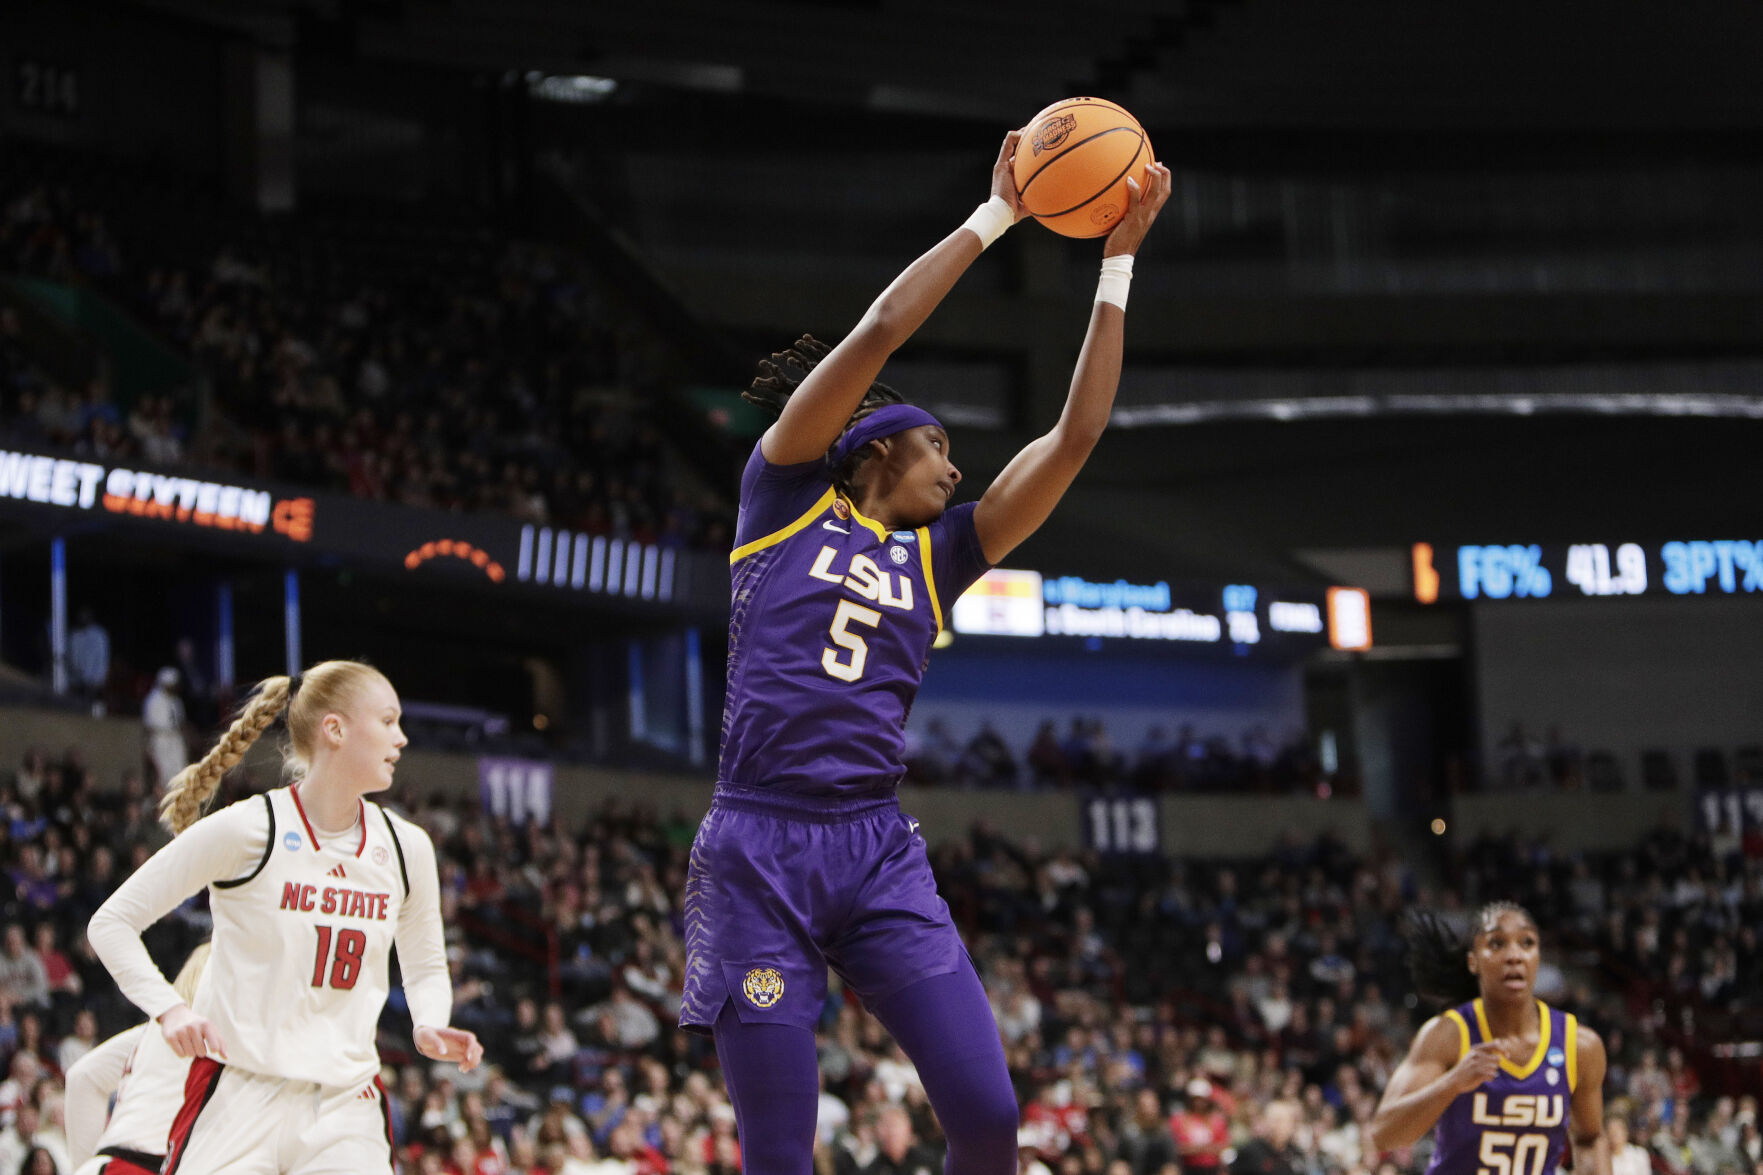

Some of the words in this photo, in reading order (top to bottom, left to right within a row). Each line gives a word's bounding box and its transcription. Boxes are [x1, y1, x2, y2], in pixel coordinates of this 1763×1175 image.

[808, 545, 914, 611] LSU
[1457, 544, 1552, 599] FG%
[821, 598, 882, 683] 5
[487, 765, 550, 828] 114
[1091, 799, 1157, 852] 113
[280, 881, 317, 912] NC
[320, 886, 390, 921] STATE
[311, 924, 366, 990] 18
[1472, 1092, 1564, 1128] LSU
[1477, 1130, 1550, 1175] 50
